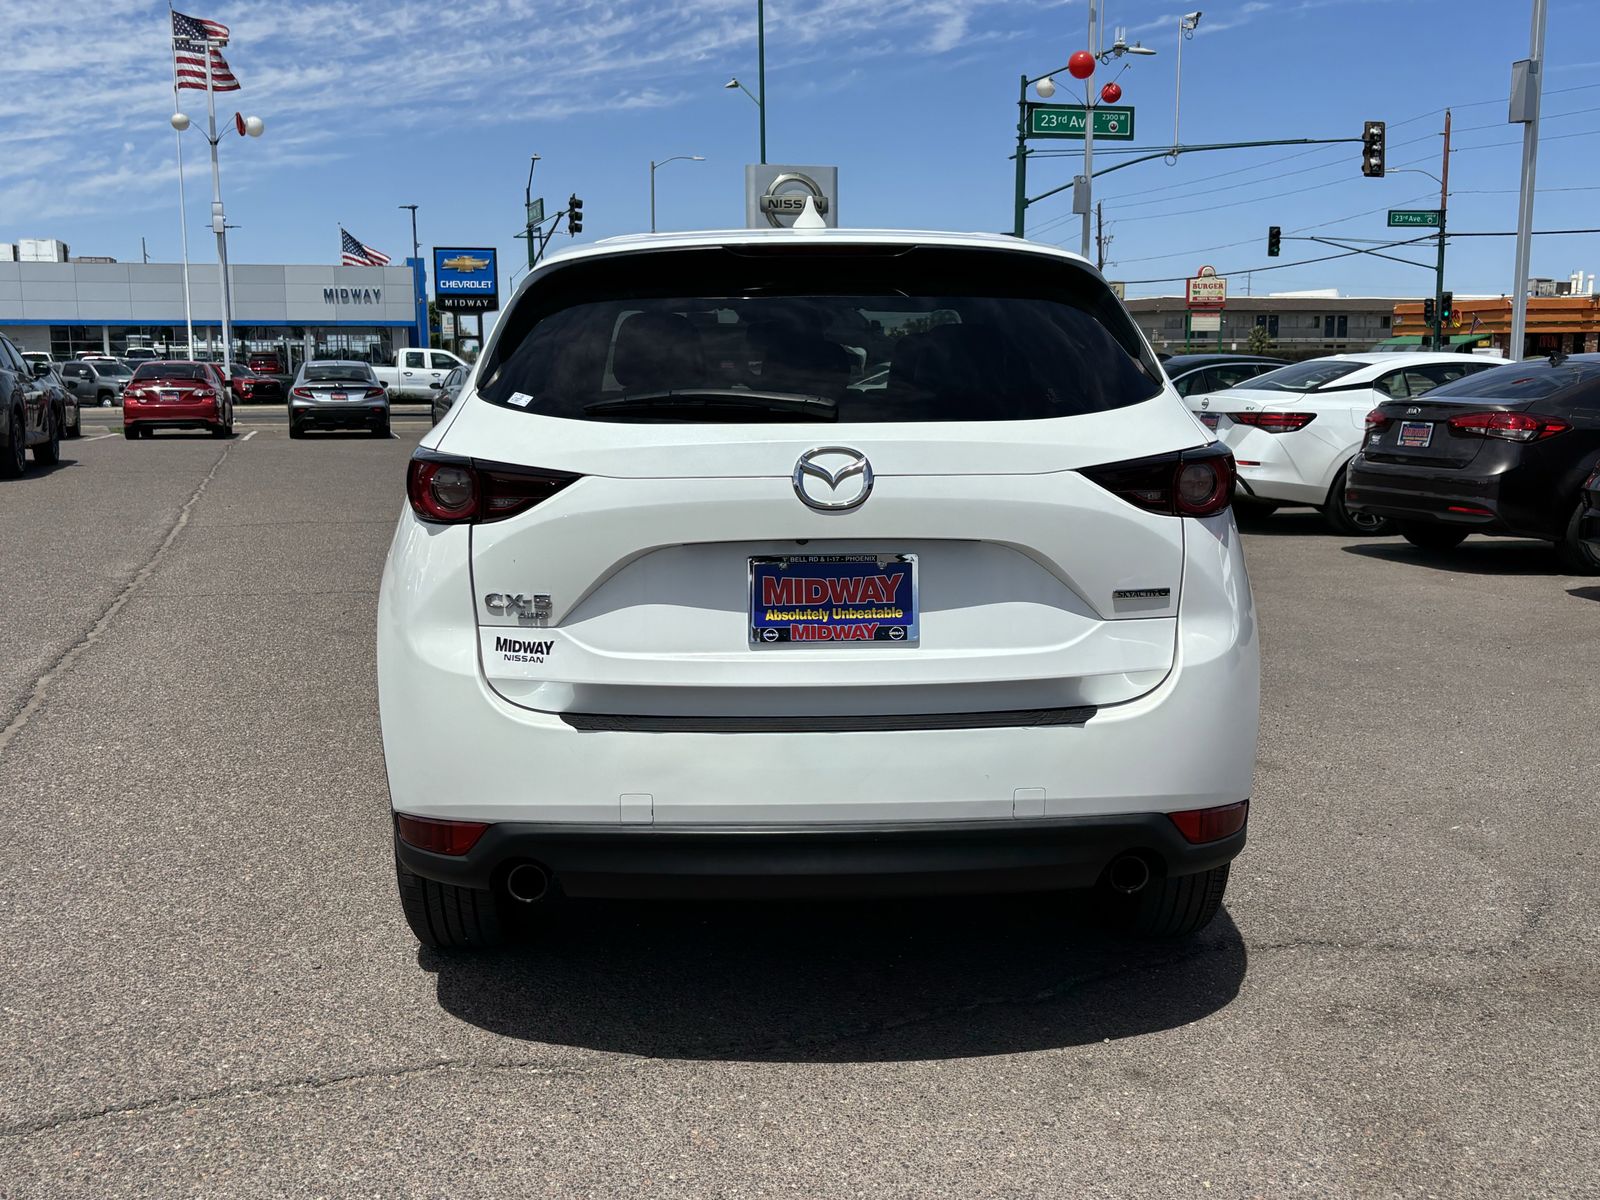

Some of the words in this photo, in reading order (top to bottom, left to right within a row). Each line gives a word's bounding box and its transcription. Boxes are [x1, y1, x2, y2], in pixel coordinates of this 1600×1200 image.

[1040, 114, 1068, 128] 23rd
[1069, 115, 1098, 128] Av.
[1102, 113, 1119, 121] 2300
[440, 280, 493, 289] CHEVROLET
[323, 288, 381, 301] MIDWAY
[444, 299, 489, 307] MIDWAY
[762, 573, 904, 606] MIDWAY
[484, 593, 553, 610] CX-5
[765, 608, 830, 622] Absolutely
[832, 607, 904, 620] Unbeatable
[790, 622, 880, 641] MIDWAY
[495, 636, 555, 655] MIDWAY
[503, 654, 544, 664] NISSAN
